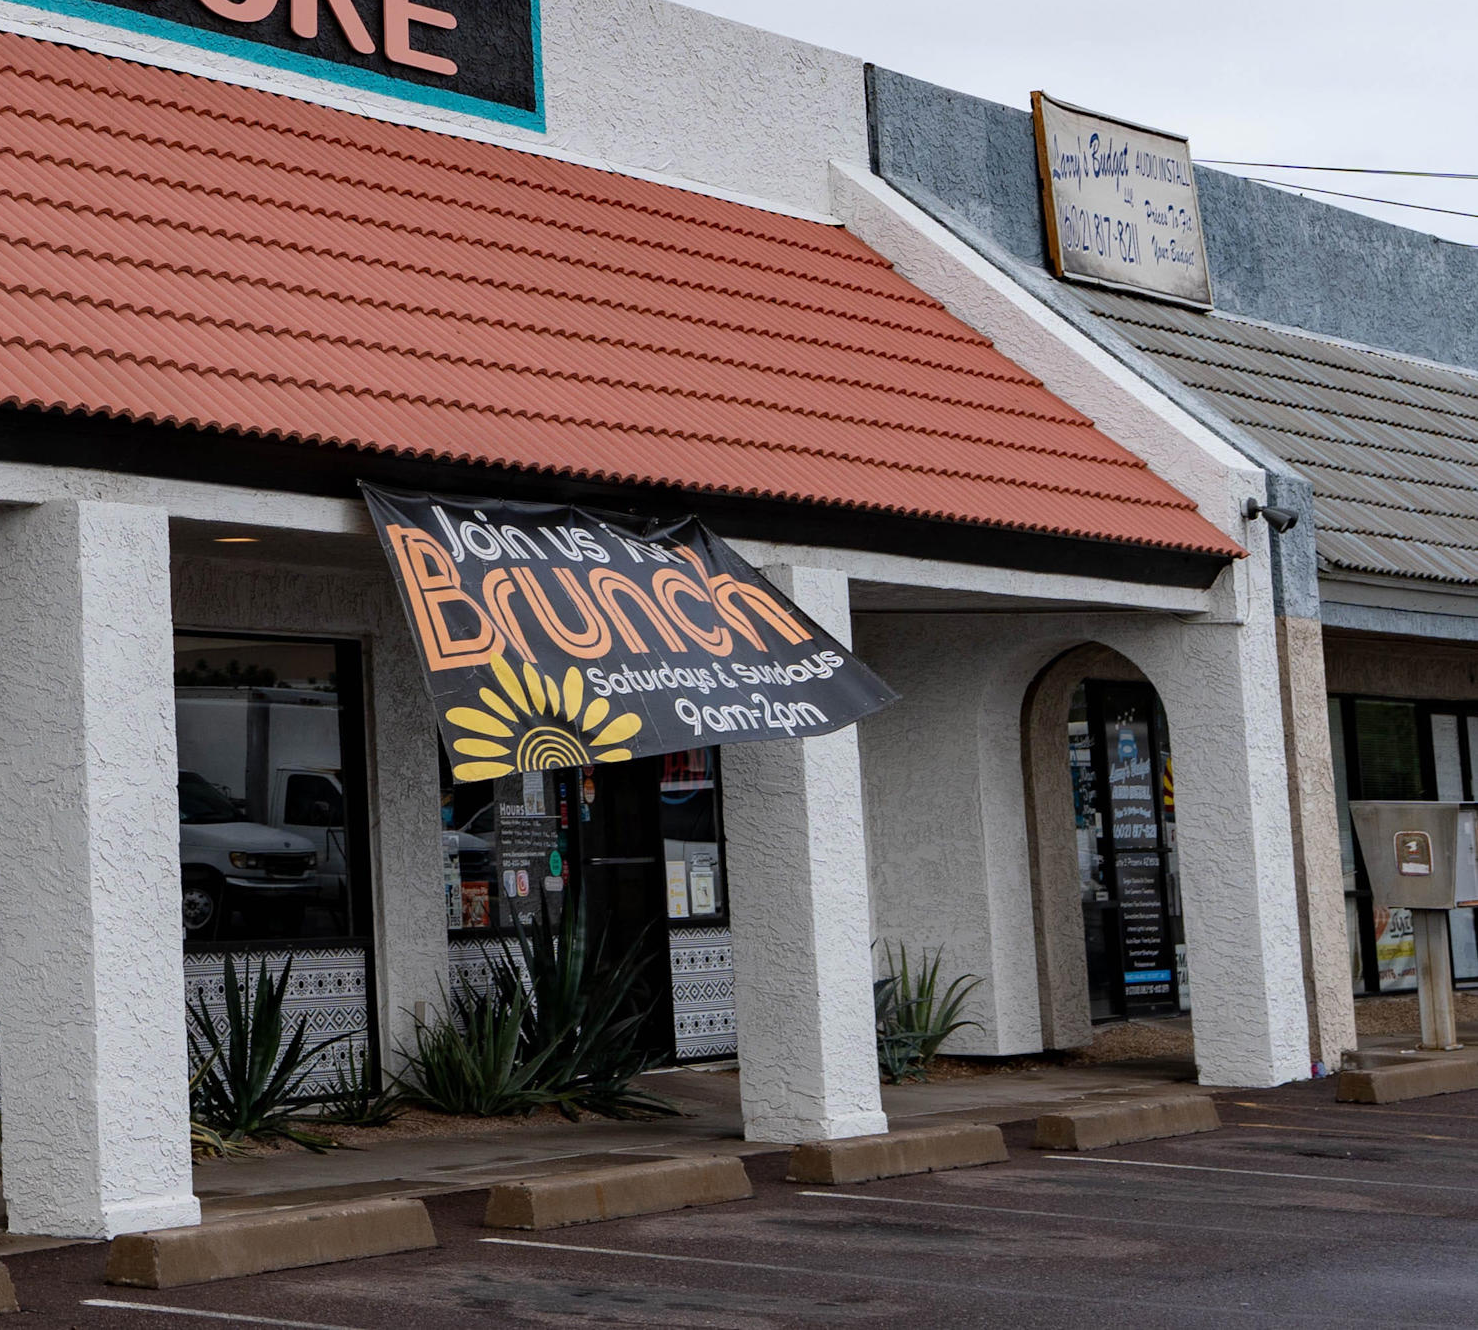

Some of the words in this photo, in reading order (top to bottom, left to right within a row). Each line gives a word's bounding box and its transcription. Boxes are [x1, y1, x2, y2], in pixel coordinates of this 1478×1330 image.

[1090, 133, 1129, 192] Budget
[1136, 150, 1158, 180] AUDIO
[1158, 156, 1190, 187] INSTALL
[1093, 213, 1142, 266] 817-8211
[431, 505, 548, 563] Join
[538, 525, 611, 564] us
[386, 523, 813, 672] Brunch
[586, 661, 717, 697] Saturdays
[714, 662, 739, 688] &
[730, 650, 845, 687] Sundays
